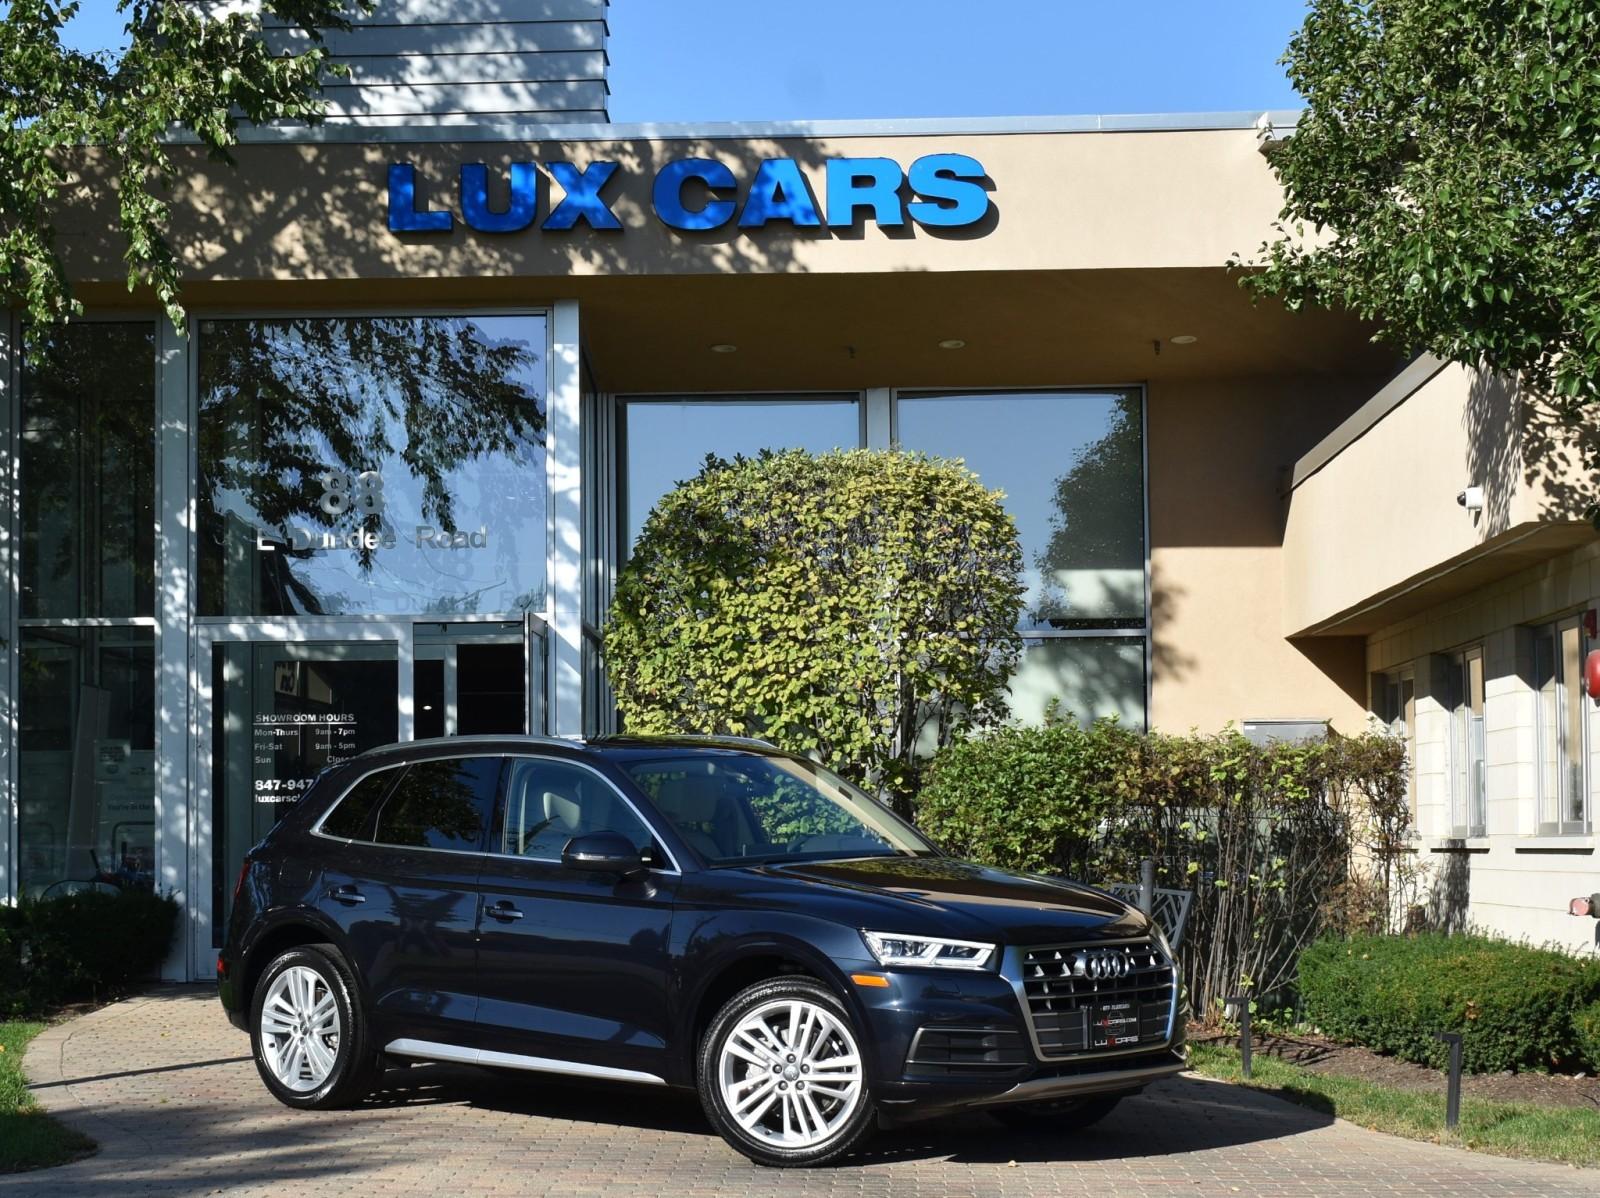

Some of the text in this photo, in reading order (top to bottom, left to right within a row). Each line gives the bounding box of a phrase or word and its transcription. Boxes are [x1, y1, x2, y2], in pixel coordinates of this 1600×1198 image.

[387, 153, 994, 234] LUX CARS
[320, 470, 385, 516] 88
[292, 526, 396, 551] Dundee
[416, 525, 488, 550] Road
[255, 713, 355, 723] SHOWROOM HOURS
[254, 728, 299, 737] Mon-Thurs
[315, 728, 332, 737] 9am
[338, 727, 356, 738] 7pm
[254, 743, 283, 752] Fri-Sat
[315, 743, 332, 751] 9am
[338, 742, 356, 752] 5pm
[327, 755, 352, 764] Clos
